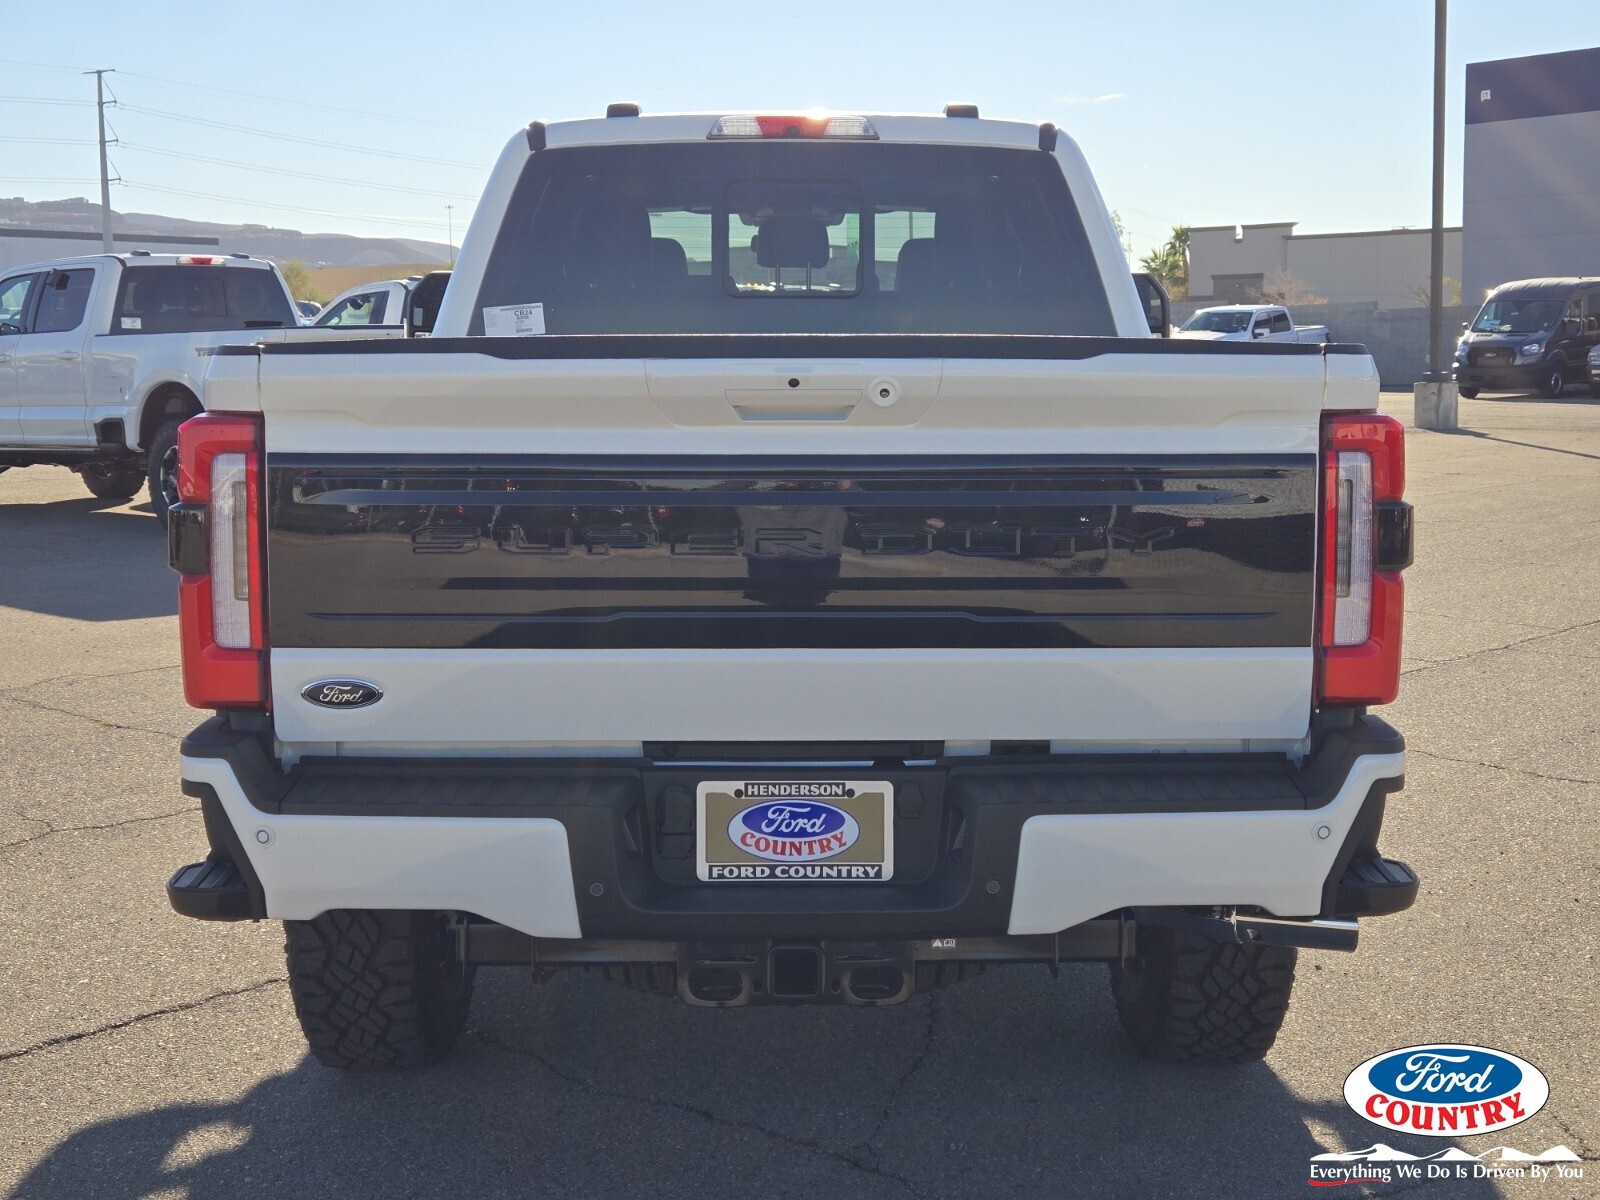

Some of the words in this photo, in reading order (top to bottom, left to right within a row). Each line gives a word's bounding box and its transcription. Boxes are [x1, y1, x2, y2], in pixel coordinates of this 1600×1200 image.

[514, 309, 533, 317] CB24
[411, 526, 825, 557] SUPER
[860, 526, 1175, 557] DUTY
[319, 684, 363, 703] Ford
[747, 784, 843, 796] HENDERSON
[761, 805, 827, 833] Ford
[740, 831, 847, 857] COUNTRY
[712, 866, 770, 878] FORD
[775, 866, 880, 878] COUNTRY
